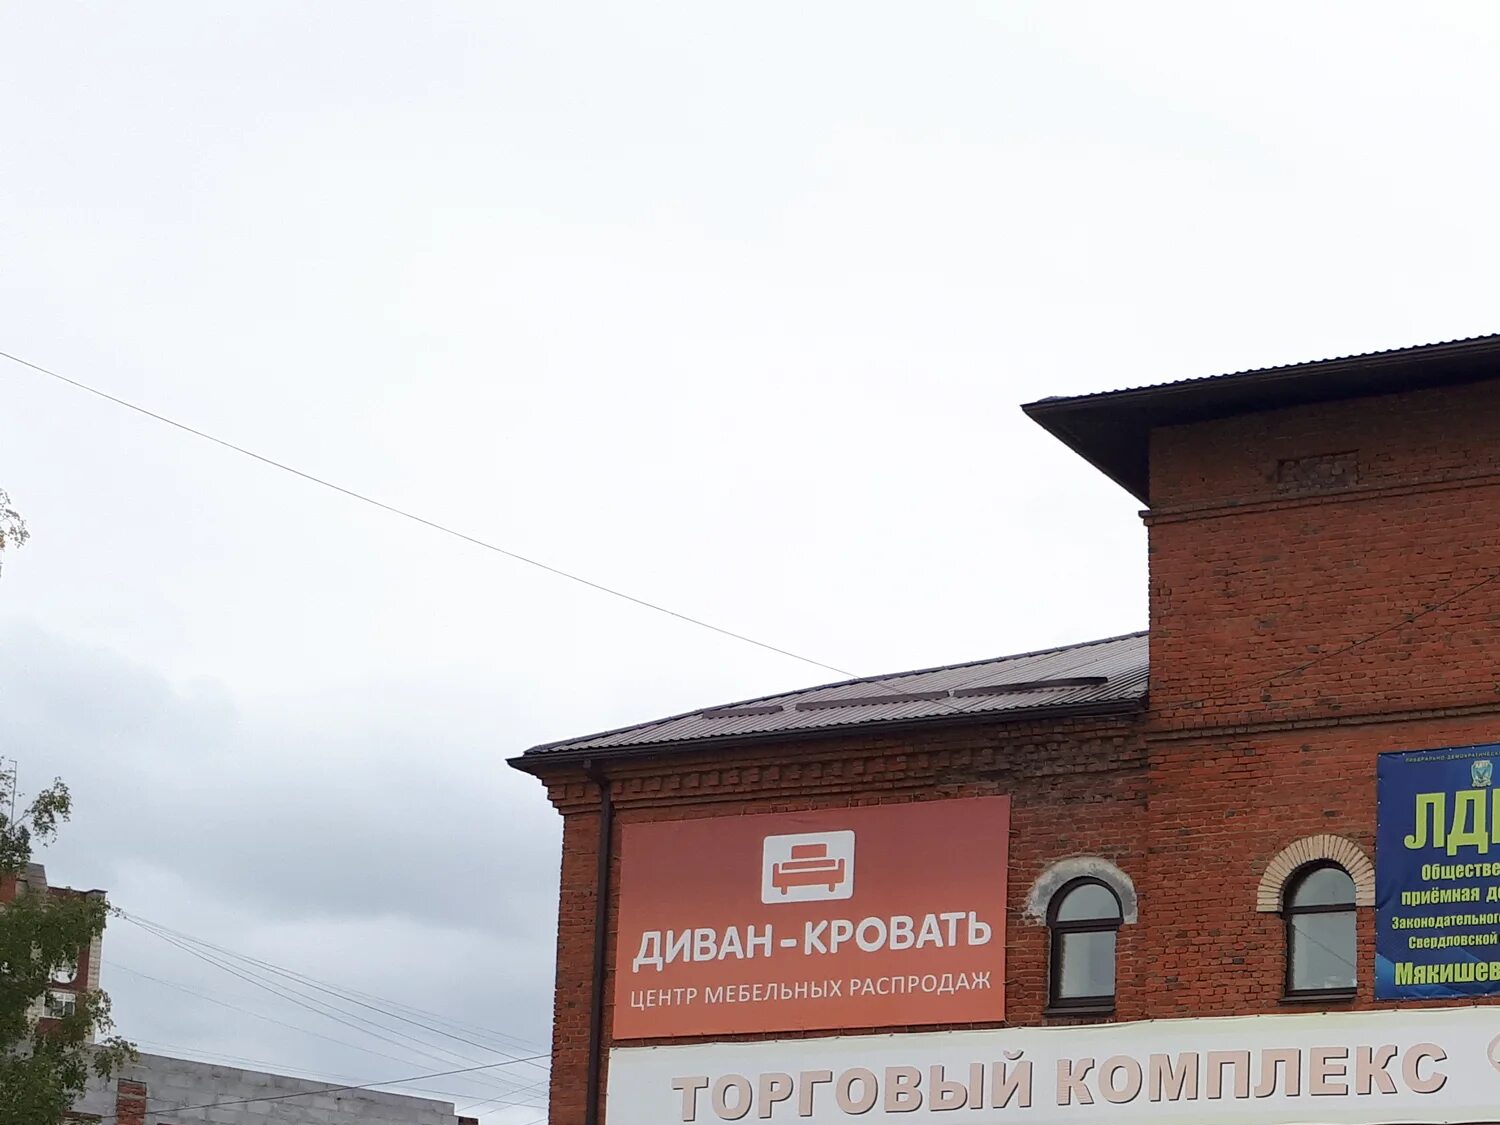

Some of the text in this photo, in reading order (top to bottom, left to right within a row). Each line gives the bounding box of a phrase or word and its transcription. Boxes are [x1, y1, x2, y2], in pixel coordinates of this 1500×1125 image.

[1401, 884, 1480, 907] приёмная
[1408, 931, 1498, 949] Свердловской
[629, 970, 992, 1010] ЦЕНТР МЕБЕЛЬНЫХ РАСПРОДАЖ
[671, 1049, 1034, 1122] ТОРГОВЫЙ
[1055, 1042, 1448, 1106] КОМПЛЕКС
